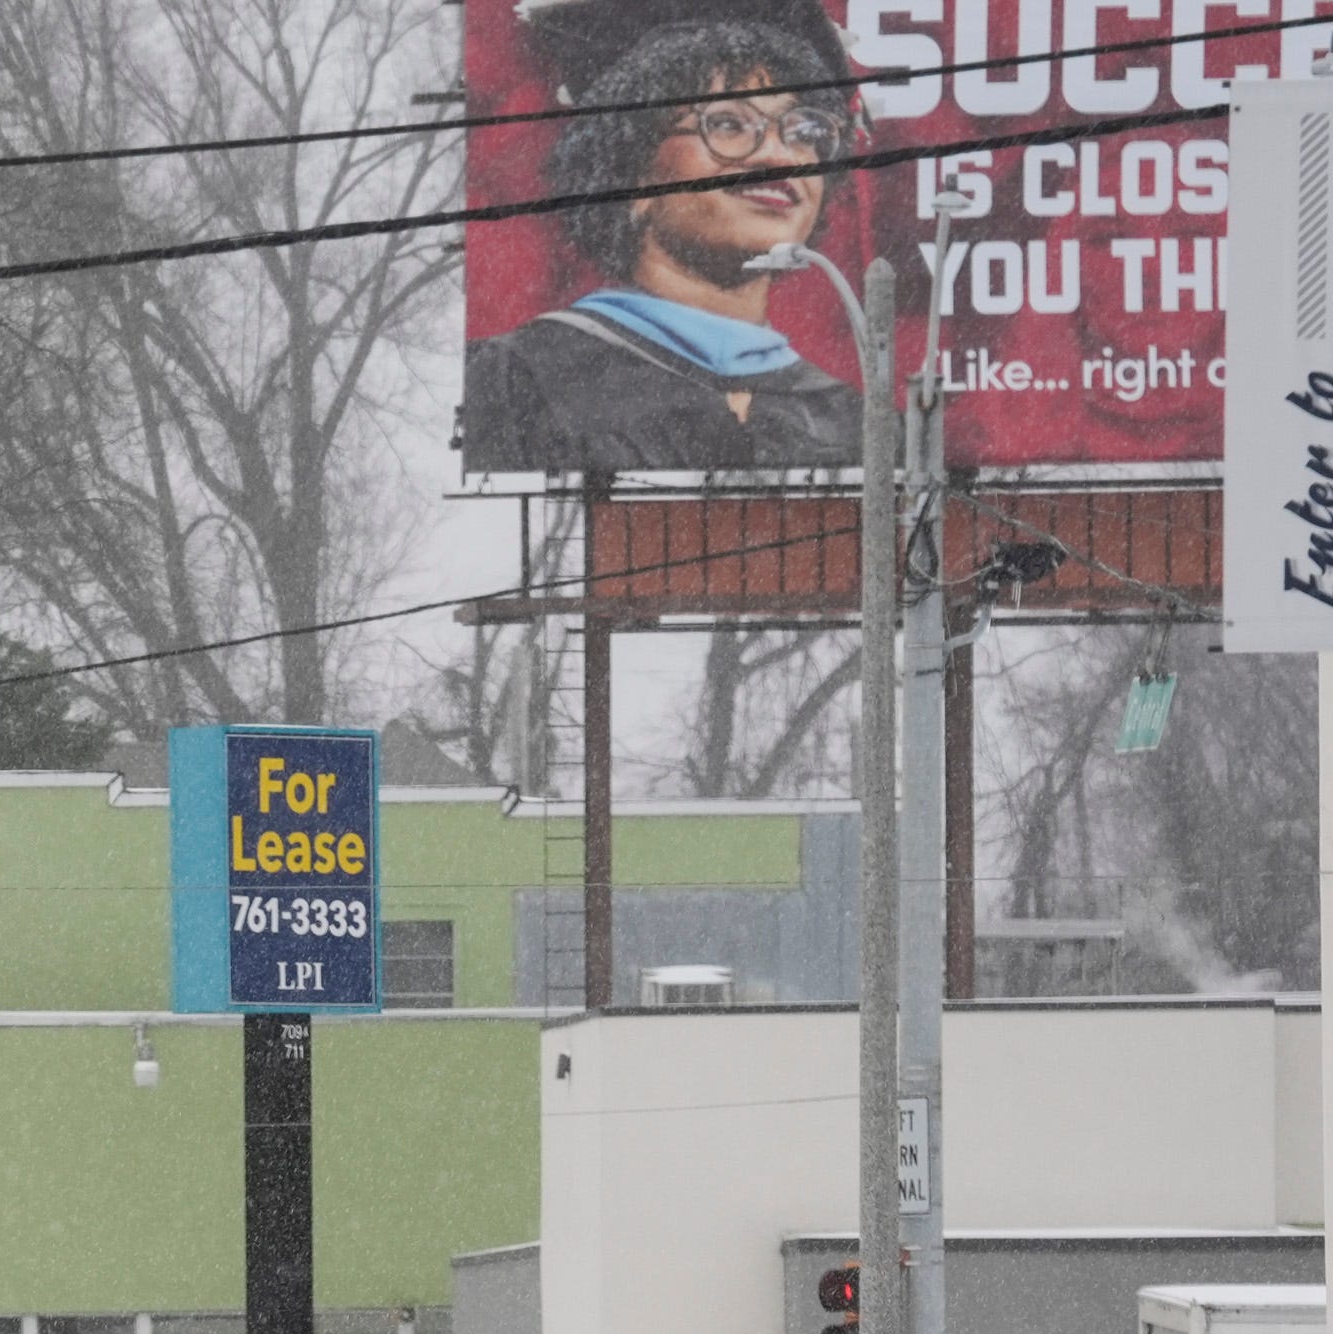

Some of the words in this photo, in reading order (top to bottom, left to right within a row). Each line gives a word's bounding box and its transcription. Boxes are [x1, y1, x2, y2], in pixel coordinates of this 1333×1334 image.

[916, 149, 993, 219] IS
[1022, 139, 1229, 216] CLOS
[918, 240, 1081, 316] YOU
[1082, 345, 1198, 400] right
[258, 757, 336, 815] For
[231, 815, 367, 876] Lease
[231, 895, 368, 939] 761-3333
[277, 961, 325, 991] LPI
[280, 1023, 303, 1040] 709
[899, 1110, 915, 1132] FT
[900, 1144, 919, 1167] RN
[899, 1179, 926, 1201] NAL
